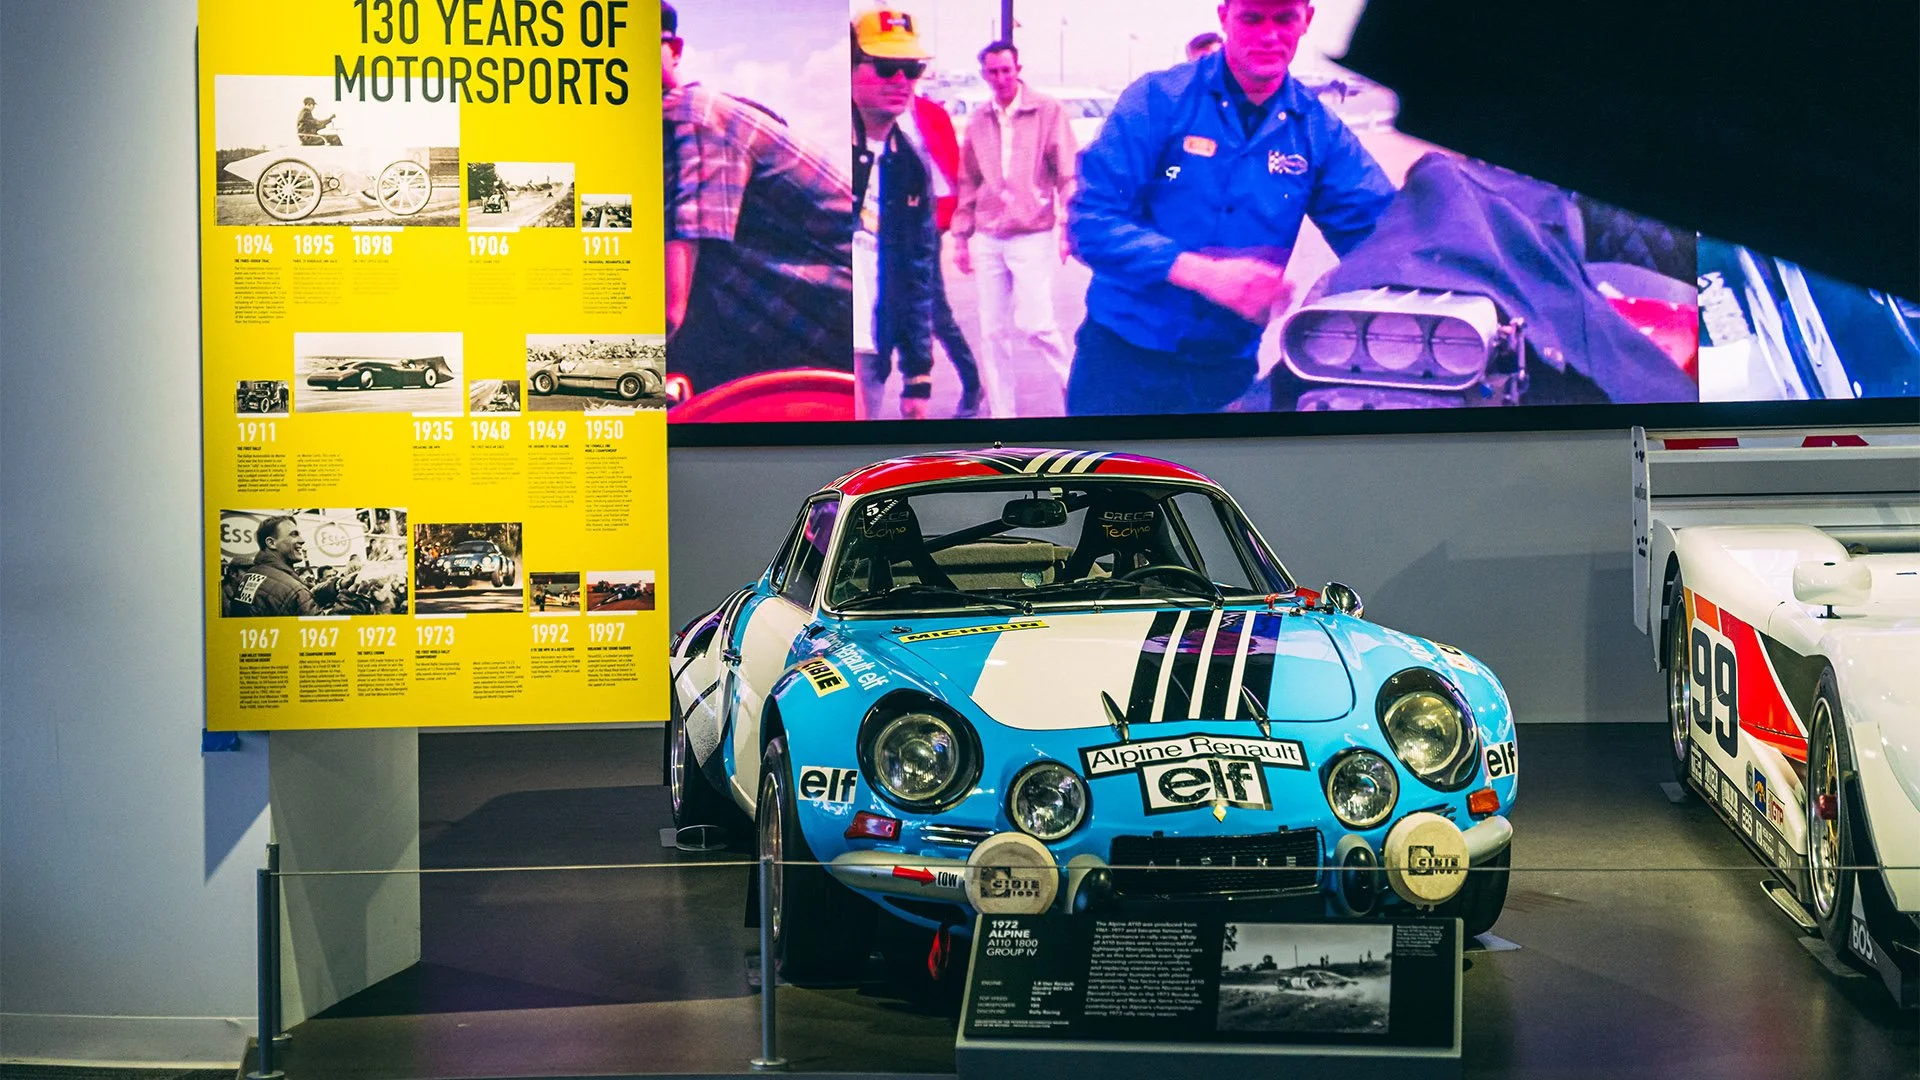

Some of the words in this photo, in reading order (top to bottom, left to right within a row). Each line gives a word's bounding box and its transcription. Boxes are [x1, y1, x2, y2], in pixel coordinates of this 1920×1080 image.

[354, 0, 418, 44] 130
[436, 0, 564, 47] YEARS
[580, 0, 628, 48] OF
[334, 54, 628, 105] MOTORSPORTS
[234, 234, 273, 254] 1894
[294, 234, 334, 255] 1895
[353, 235, 392, 255] 1898
[468, 235, 509, 256] 1906
[583, 236, 619, 256] 1911
[238, 422, 276, 442] 1911
[413, 421, 454, 440] 1935
[470, 421, 510, 441] 1948
[528, 420, 567, 440] 1949
[585, 420, 624, 440] 1950
[866, 502, 879, 516] 5
[220, 524, 252, 543] Ess
[1102, 523, 1150, 540] Techno
[240, 629, 280, 648] 1967
[300, 628, 339, 648] 1967
[357, 626, 396, 647] 1972
[416, 625, 455, 646] 1973
[531, 623, 569, 643] 1992
[588, 622, 625, 642] 1997
[906, 621, 1041, 641] MICHELIN
[832, 642, 875, 675] Renault
[858, 672, 889, 690] elf
[1692, 627, 1738, 758] 99
[1092, 744, 1182, 768] Alpine
[1189, 738, 1299, 761] Renault
[1486, 742, 1516, 777] elf
[800, 770, 857, 802] elf
[1158, 760, 1253, 803] elf
[937, 872, 958, 887] TOW
[989, 930, 1030, 938] ALPINE
[992, 920, 1019, 928] 1972
[1853, 918, 1877, 964] BOS
[986, 948, 1024, 956] GROUP
